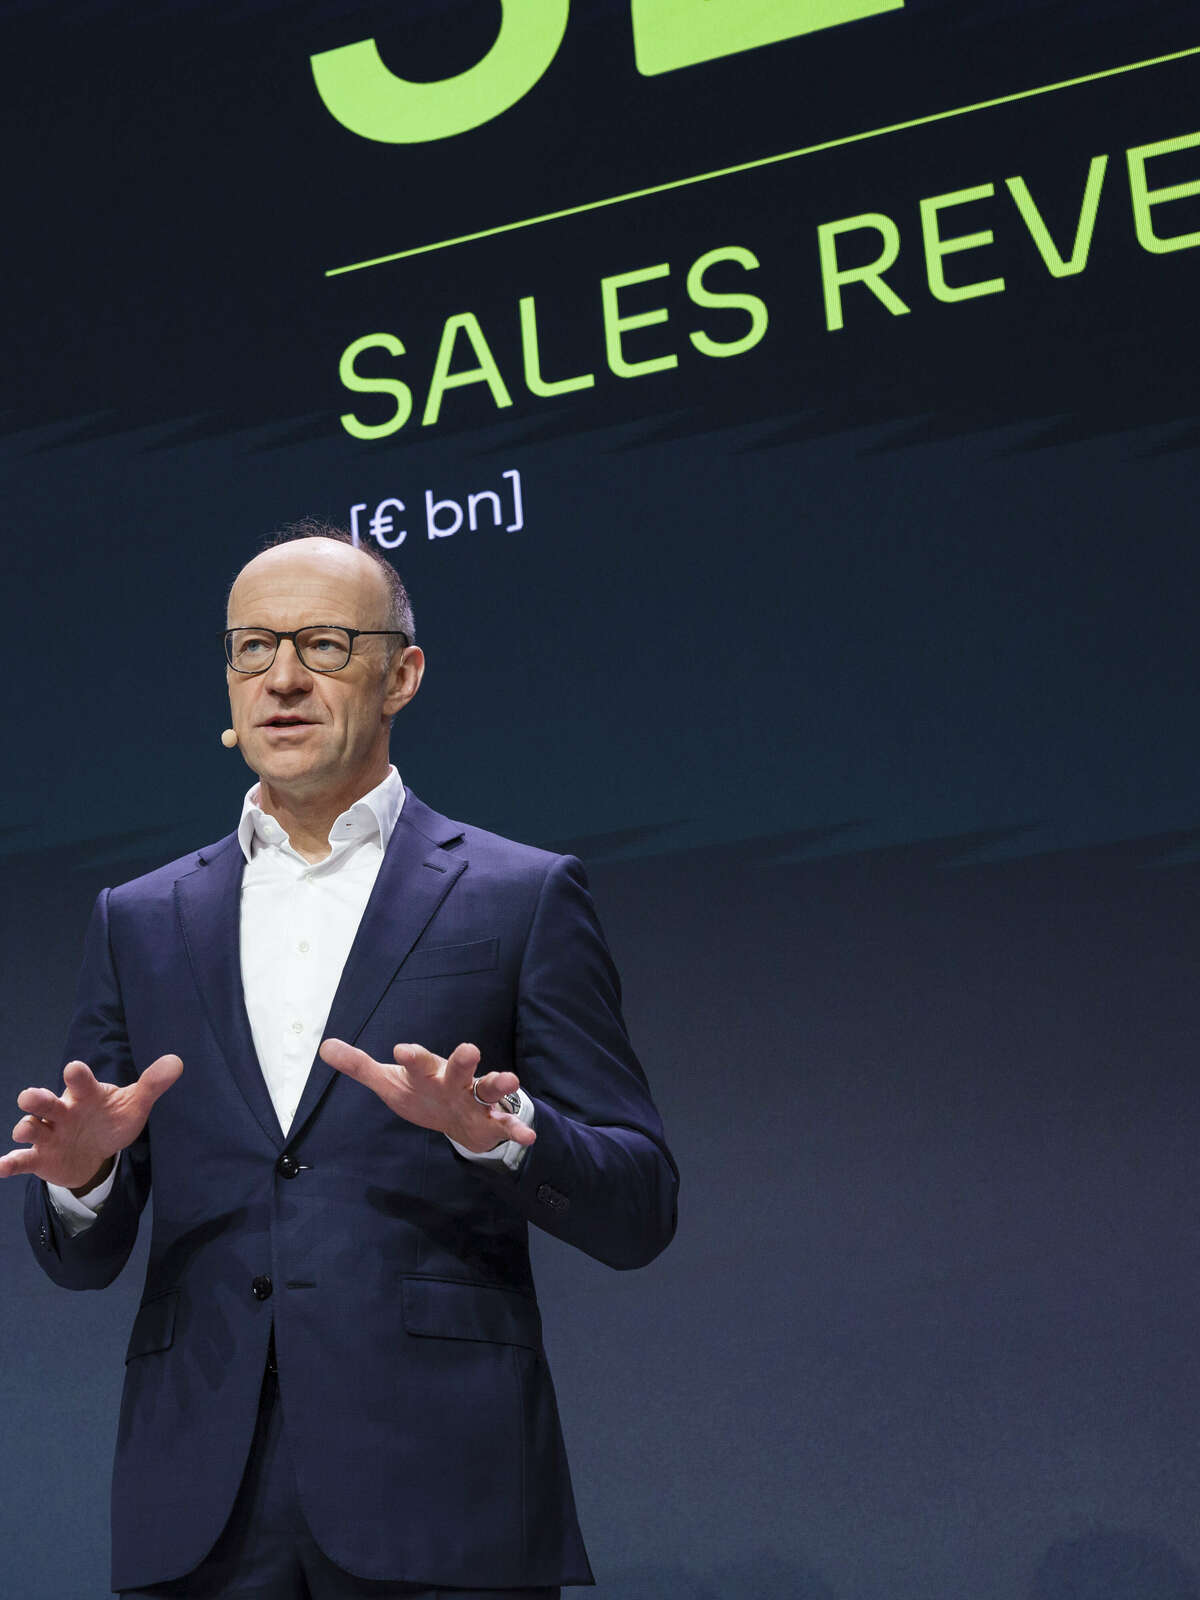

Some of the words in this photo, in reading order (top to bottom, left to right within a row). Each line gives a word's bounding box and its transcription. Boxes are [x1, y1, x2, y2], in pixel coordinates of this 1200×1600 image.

[338, 245, 770, 441] SALES
[817, 131, 1200, 333] REVE
[425, 468, 525, 541] bn]
